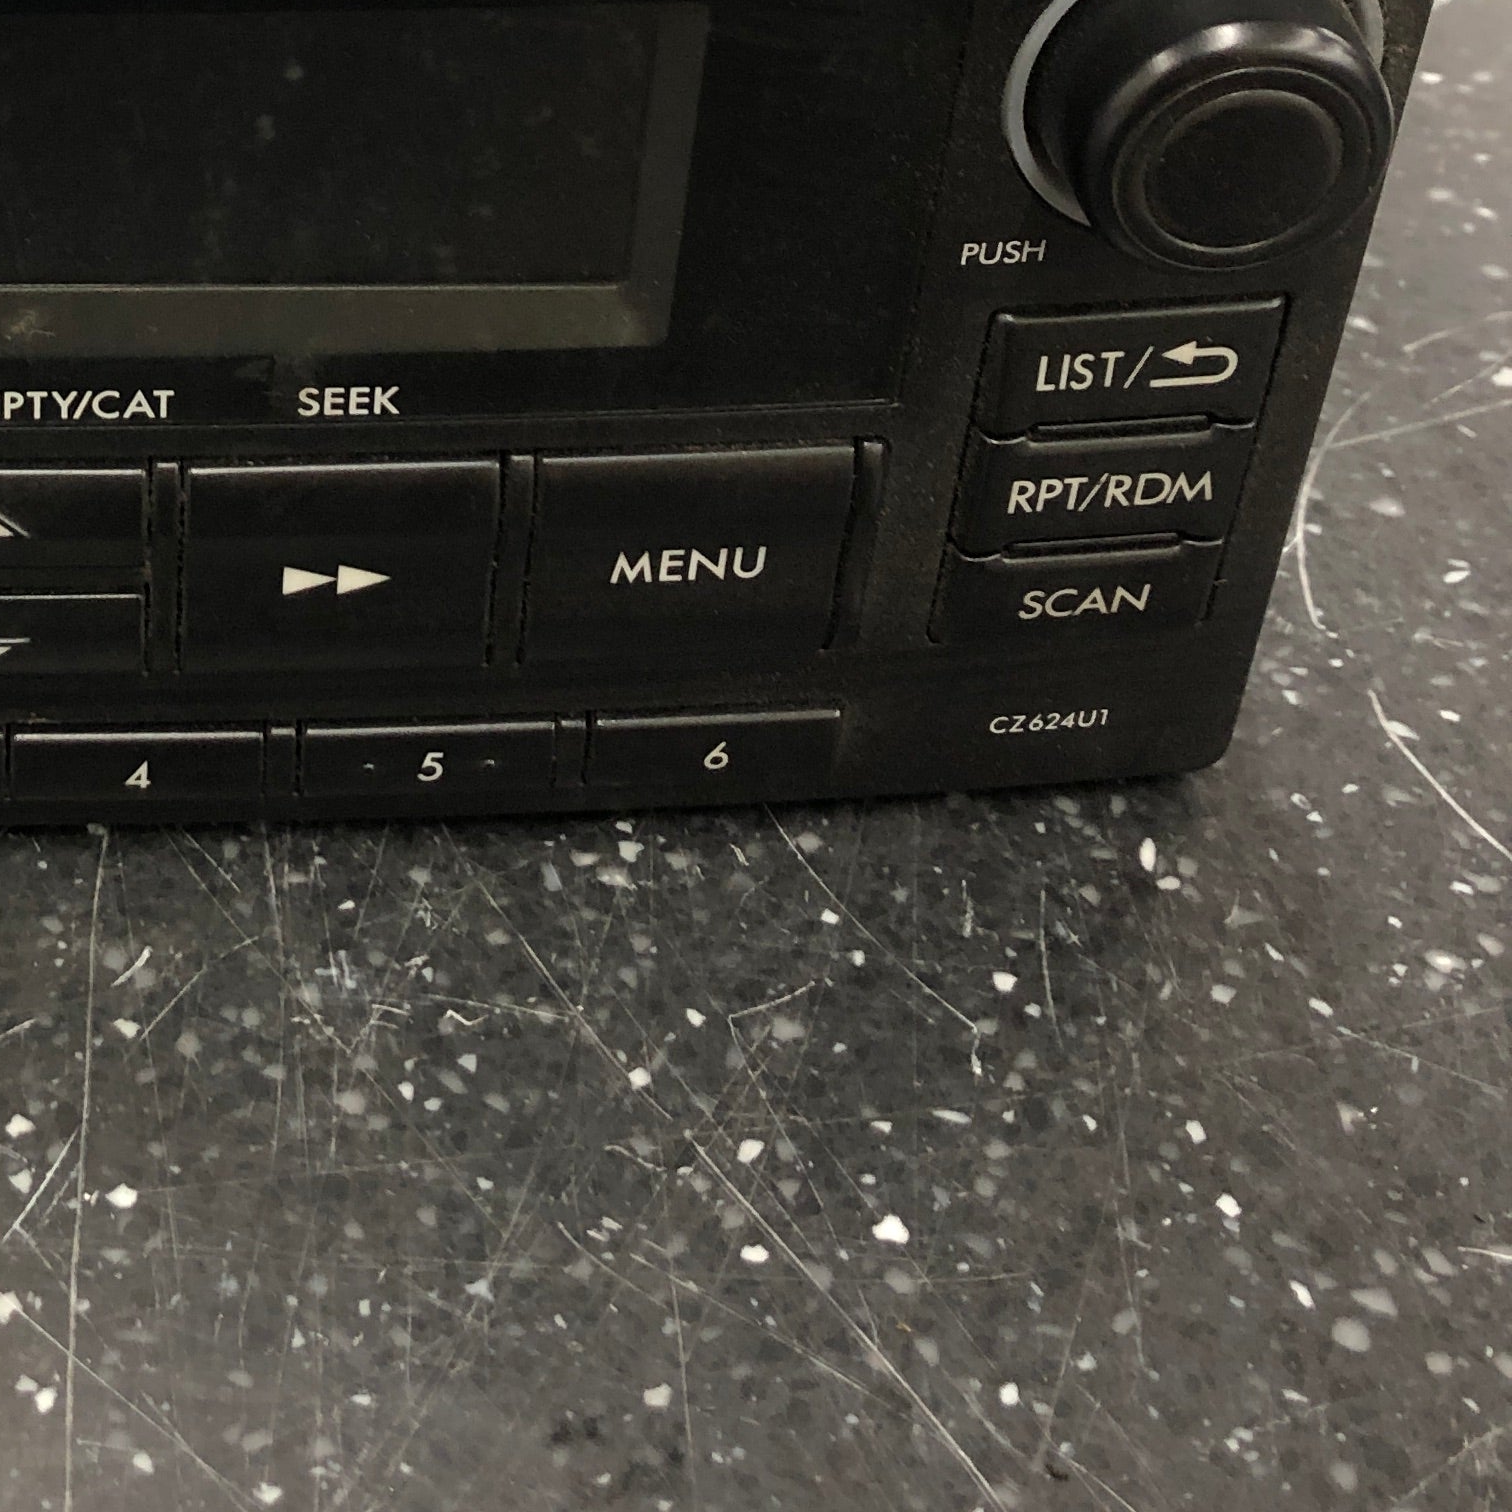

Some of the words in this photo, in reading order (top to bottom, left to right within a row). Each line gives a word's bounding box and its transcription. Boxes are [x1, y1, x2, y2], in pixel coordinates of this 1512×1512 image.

[961, 240, 1047, 266] PUSH
[298, 387, 401, 418] SEEK
[1007, 472, 1213, 515] RPT/RDM
[611, 546, 767, 584] MENU
[1018, 584, 1151, 620] SCAN
[989, 710, 1109, 735] CZ624U1
[417, 752, 444, 783] 5
[703, 741, 730, 771] 6
[124, 761, 151, 790] 4
